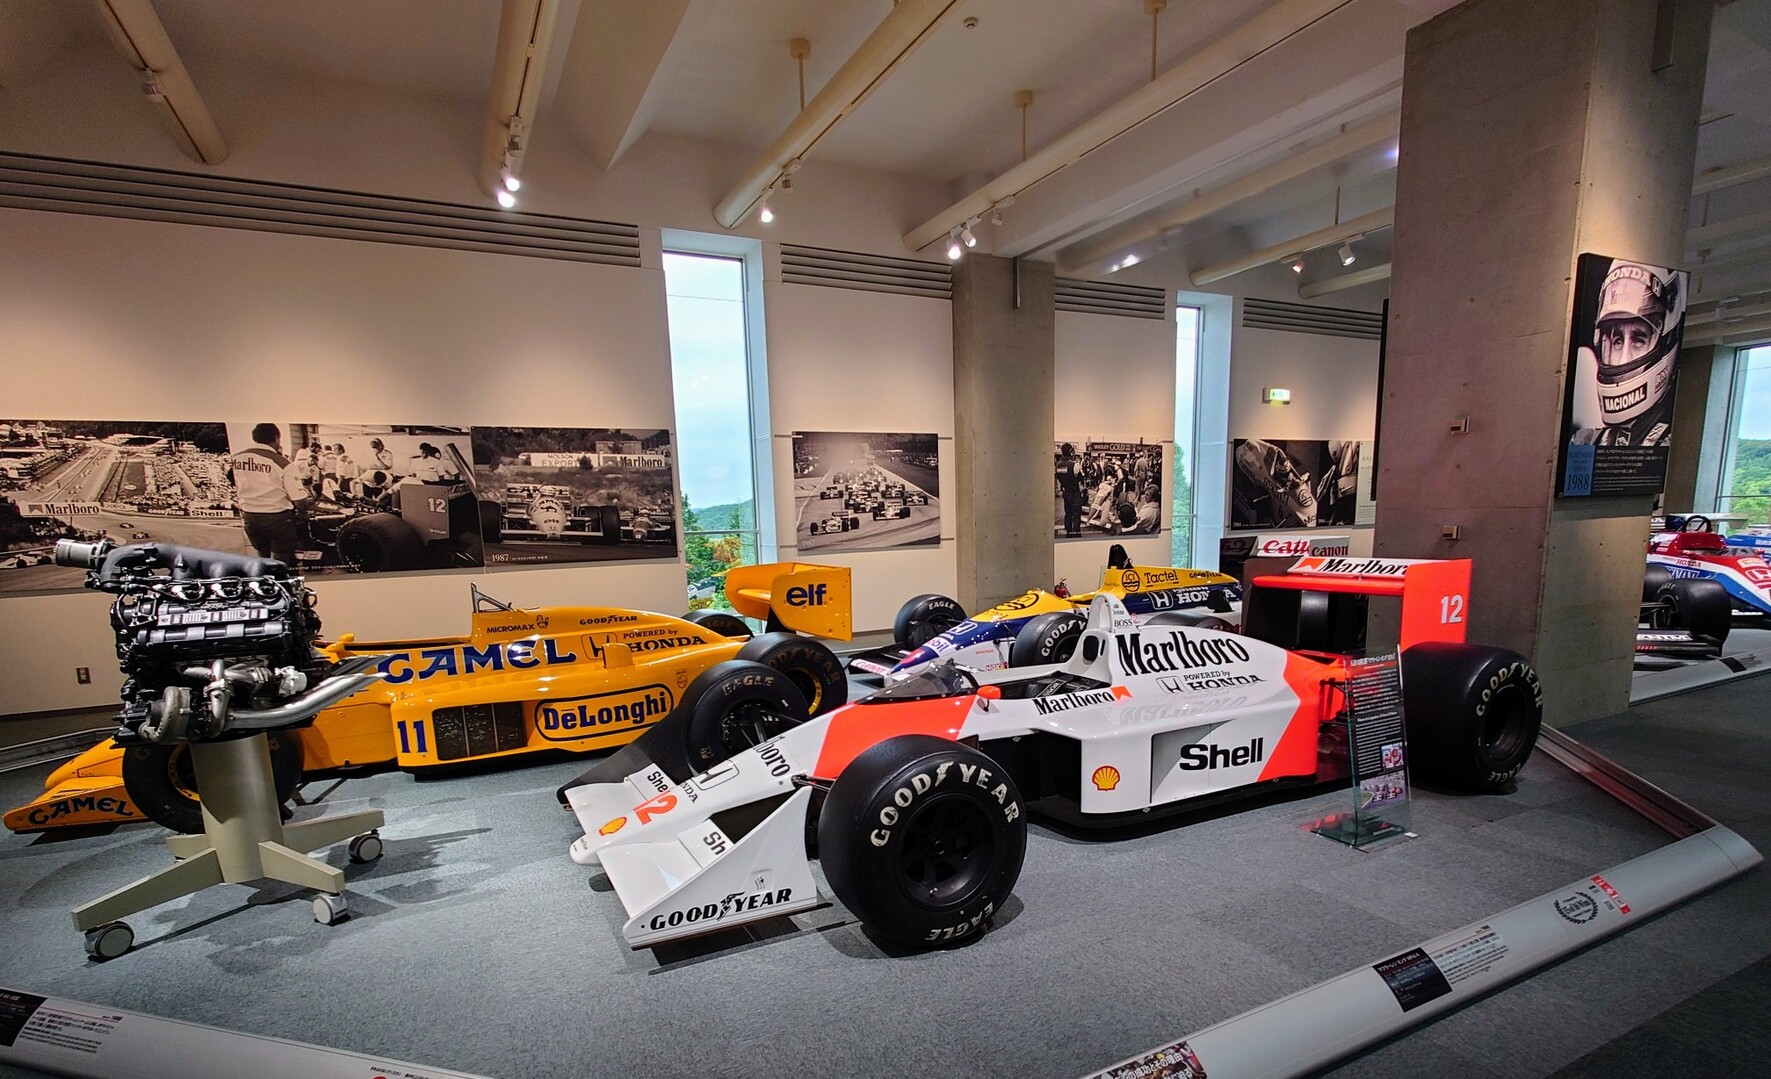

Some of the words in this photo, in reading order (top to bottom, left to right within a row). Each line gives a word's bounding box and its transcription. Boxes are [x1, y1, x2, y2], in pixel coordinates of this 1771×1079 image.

[1604, 389, 1646, 411] NACIONAL
[231, 456, 272, 474] Marlboro
[619, 455, 663, 468] Marlboro
[1567, 474, 1590, 491] 1988
[45, 503, 99, 515] Marlboro
[191, 509, 223, 517] Shell
[428, 497, 446, 513] 12
[1263, 540, 1309, 555] Can
[491, 553, 509, 562] 1987
[1676, 558, 1701, 567] HONDA
[1125, 573, 1135, 581] ICI
[1144, 569, 1179, 584] Tactel
[786, 583, 827, 607] elf
[1176, 588, 1236, 604] HONA
[928, 600, 955, 610] EAGLE
[1441, 595, 1463, 624] 12
[486, 623, 535, 634] MICROMAX
[1114, 619, 1133, 627] BOSS
[623, 629, 666, 639] POWERED
[668, 628, 678, 636] by
[1041, 619, 1086, 657] GOODY
[627, 635, 707, 653] HONDA
[377, 638, 577, 684] CAMEL
[1115, 630, 1250, 677] Marlboro
[1183, 671, 1221, 681] POWERED
[1222, 670, 1231, 679] by
[1184, 674, 1266, 691] HONDA
[722, 675, 774, 696] EAGLE
[1031, 689, 1115, 716] Marlboro
[397, 719, 428, 753] 11
[753, 736, 790, 777] boro
[1179, 736, 1264, 771] Shell
[1488, 762, 1521, 782] EAGLE
[647, 771, 668, 793] She
[682, 782, 699, 804] NDA
[28, 796, 134, 825] CAMEL
[925, 901, 994, 941] EAGLE
